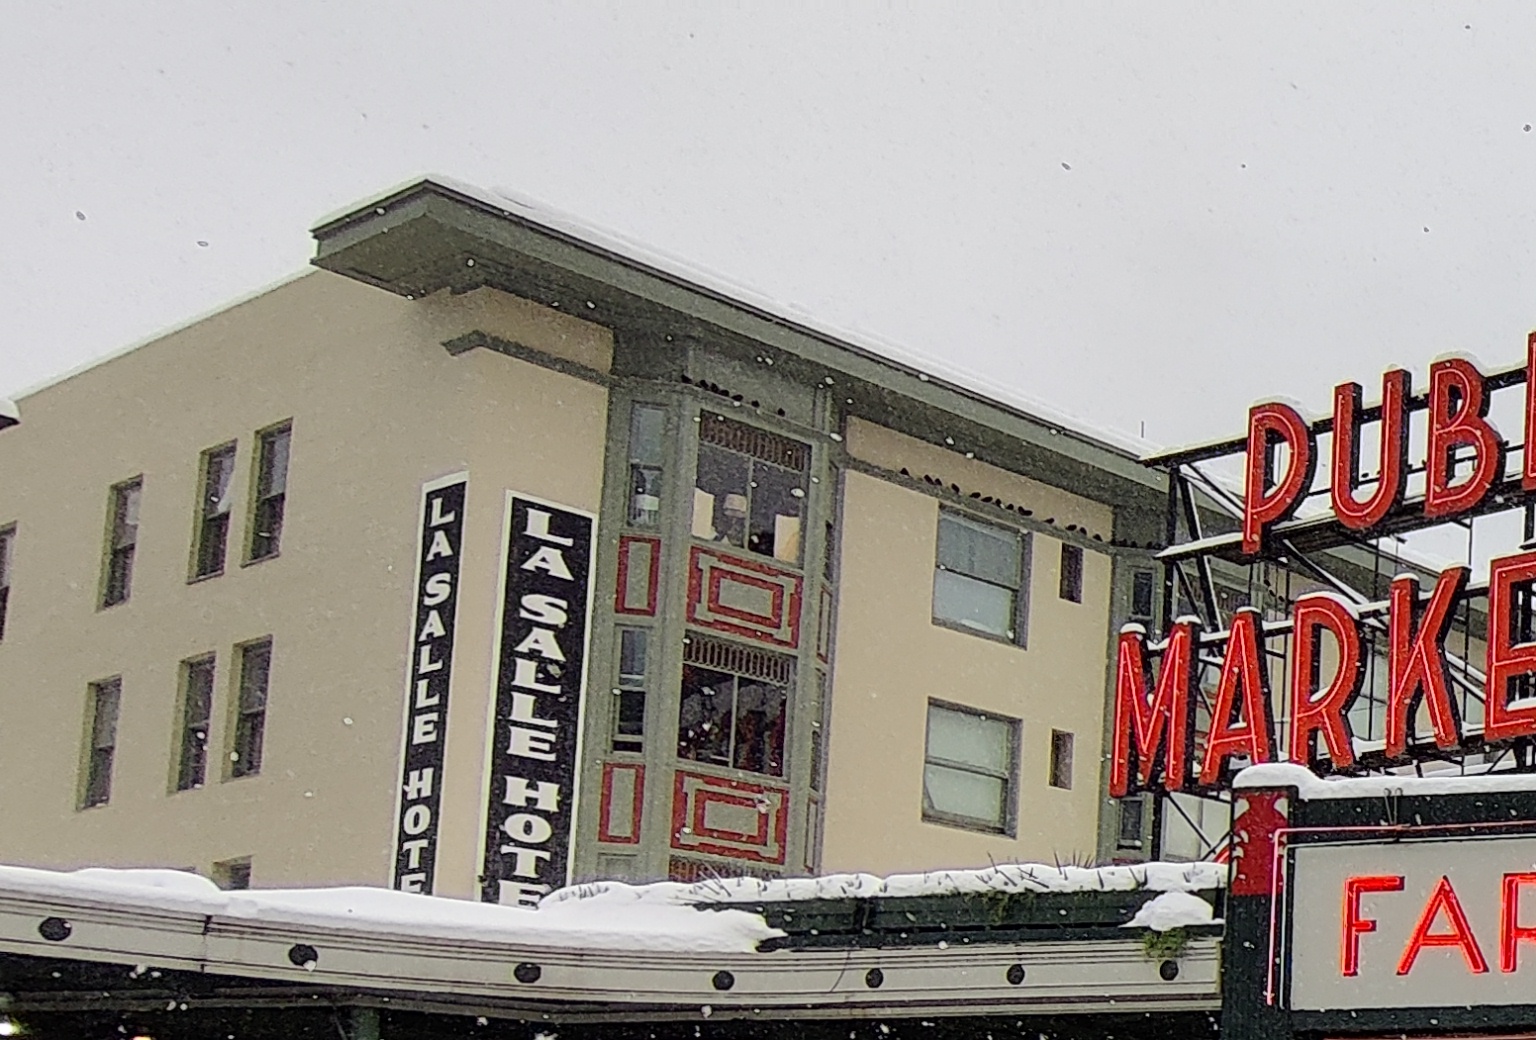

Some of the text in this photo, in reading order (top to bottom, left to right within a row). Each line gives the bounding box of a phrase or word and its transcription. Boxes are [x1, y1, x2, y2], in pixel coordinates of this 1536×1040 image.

[426, 497, 455, 562] LA
[521, 507, 574, 581] LA
[412, 573, 451, 745] SALLE
[506, 594, 568, 761] SALLE
